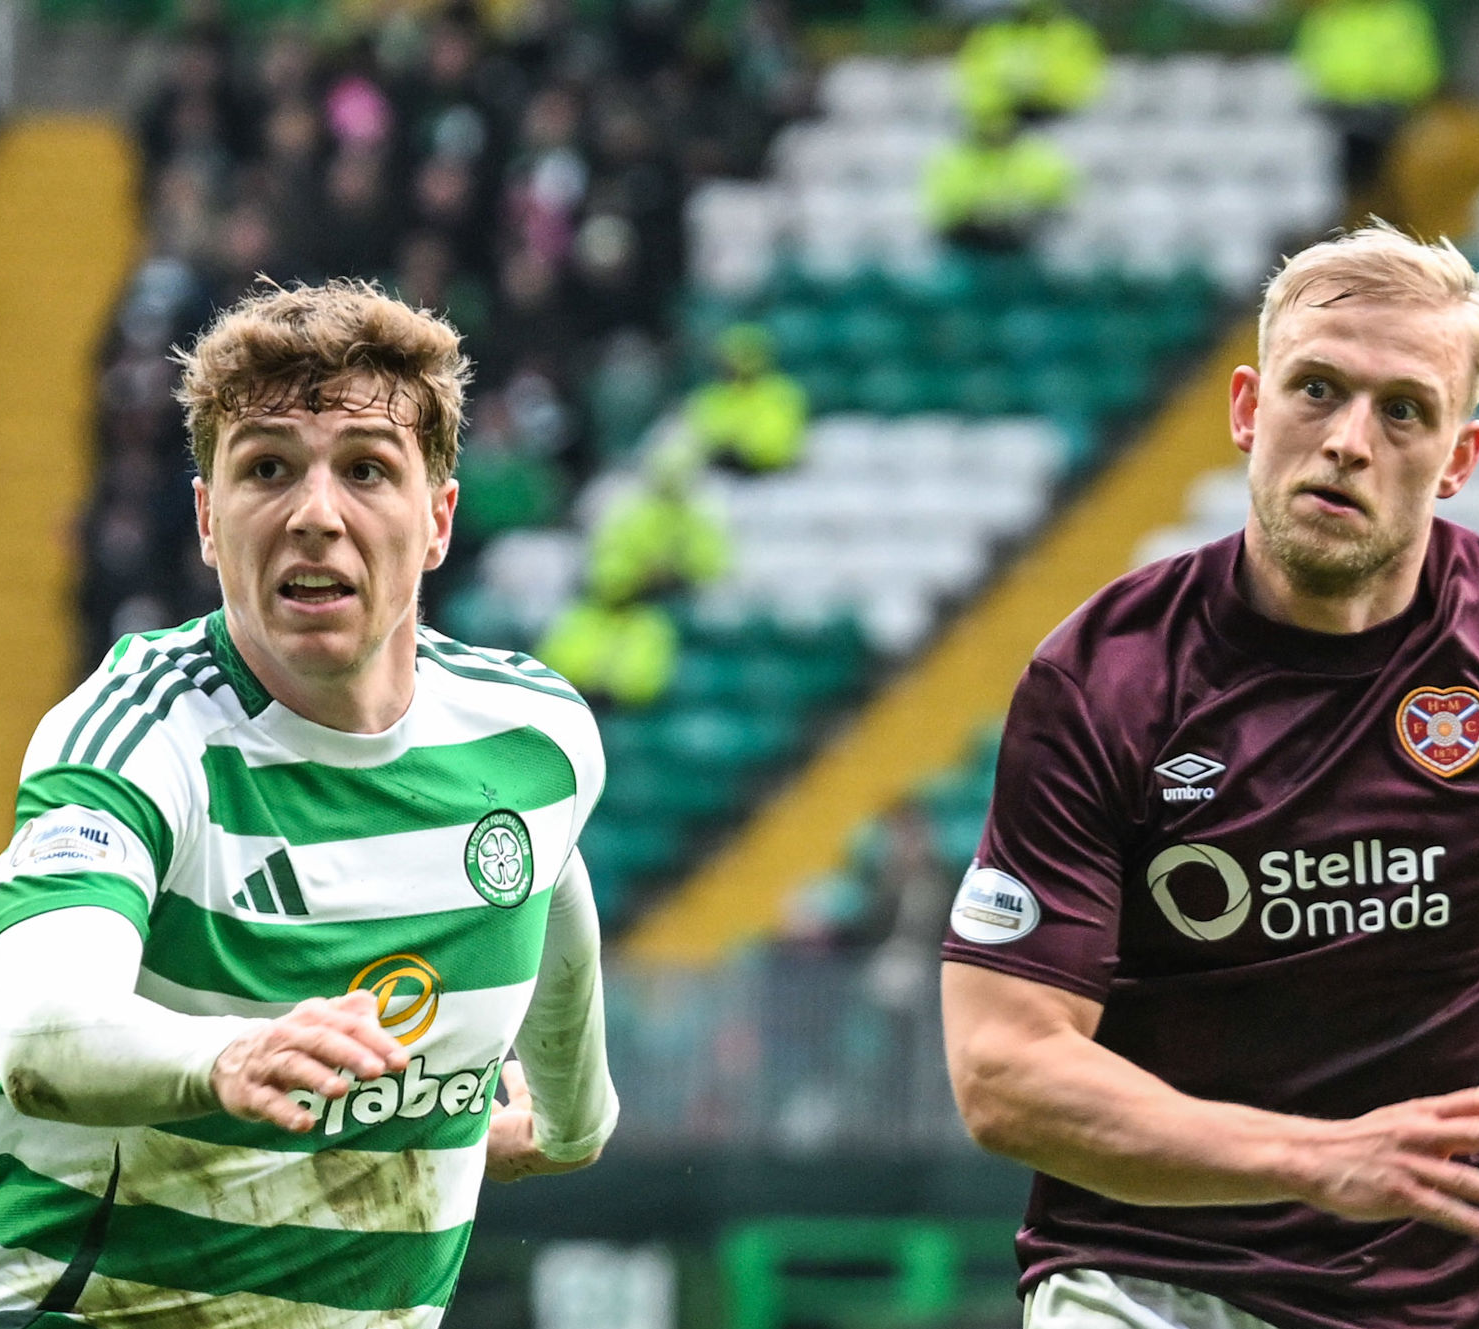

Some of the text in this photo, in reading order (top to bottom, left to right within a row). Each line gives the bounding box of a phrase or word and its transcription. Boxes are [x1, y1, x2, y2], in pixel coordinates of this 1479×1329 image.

[1162, 784, 1215, 801] umbro
[79, 826, 109, 846] HILL
[1259, 838, 1446, 895] Stellar
[994, 892, 1023, 913] HILL
[1259, 883, 1450, 940] Omada
